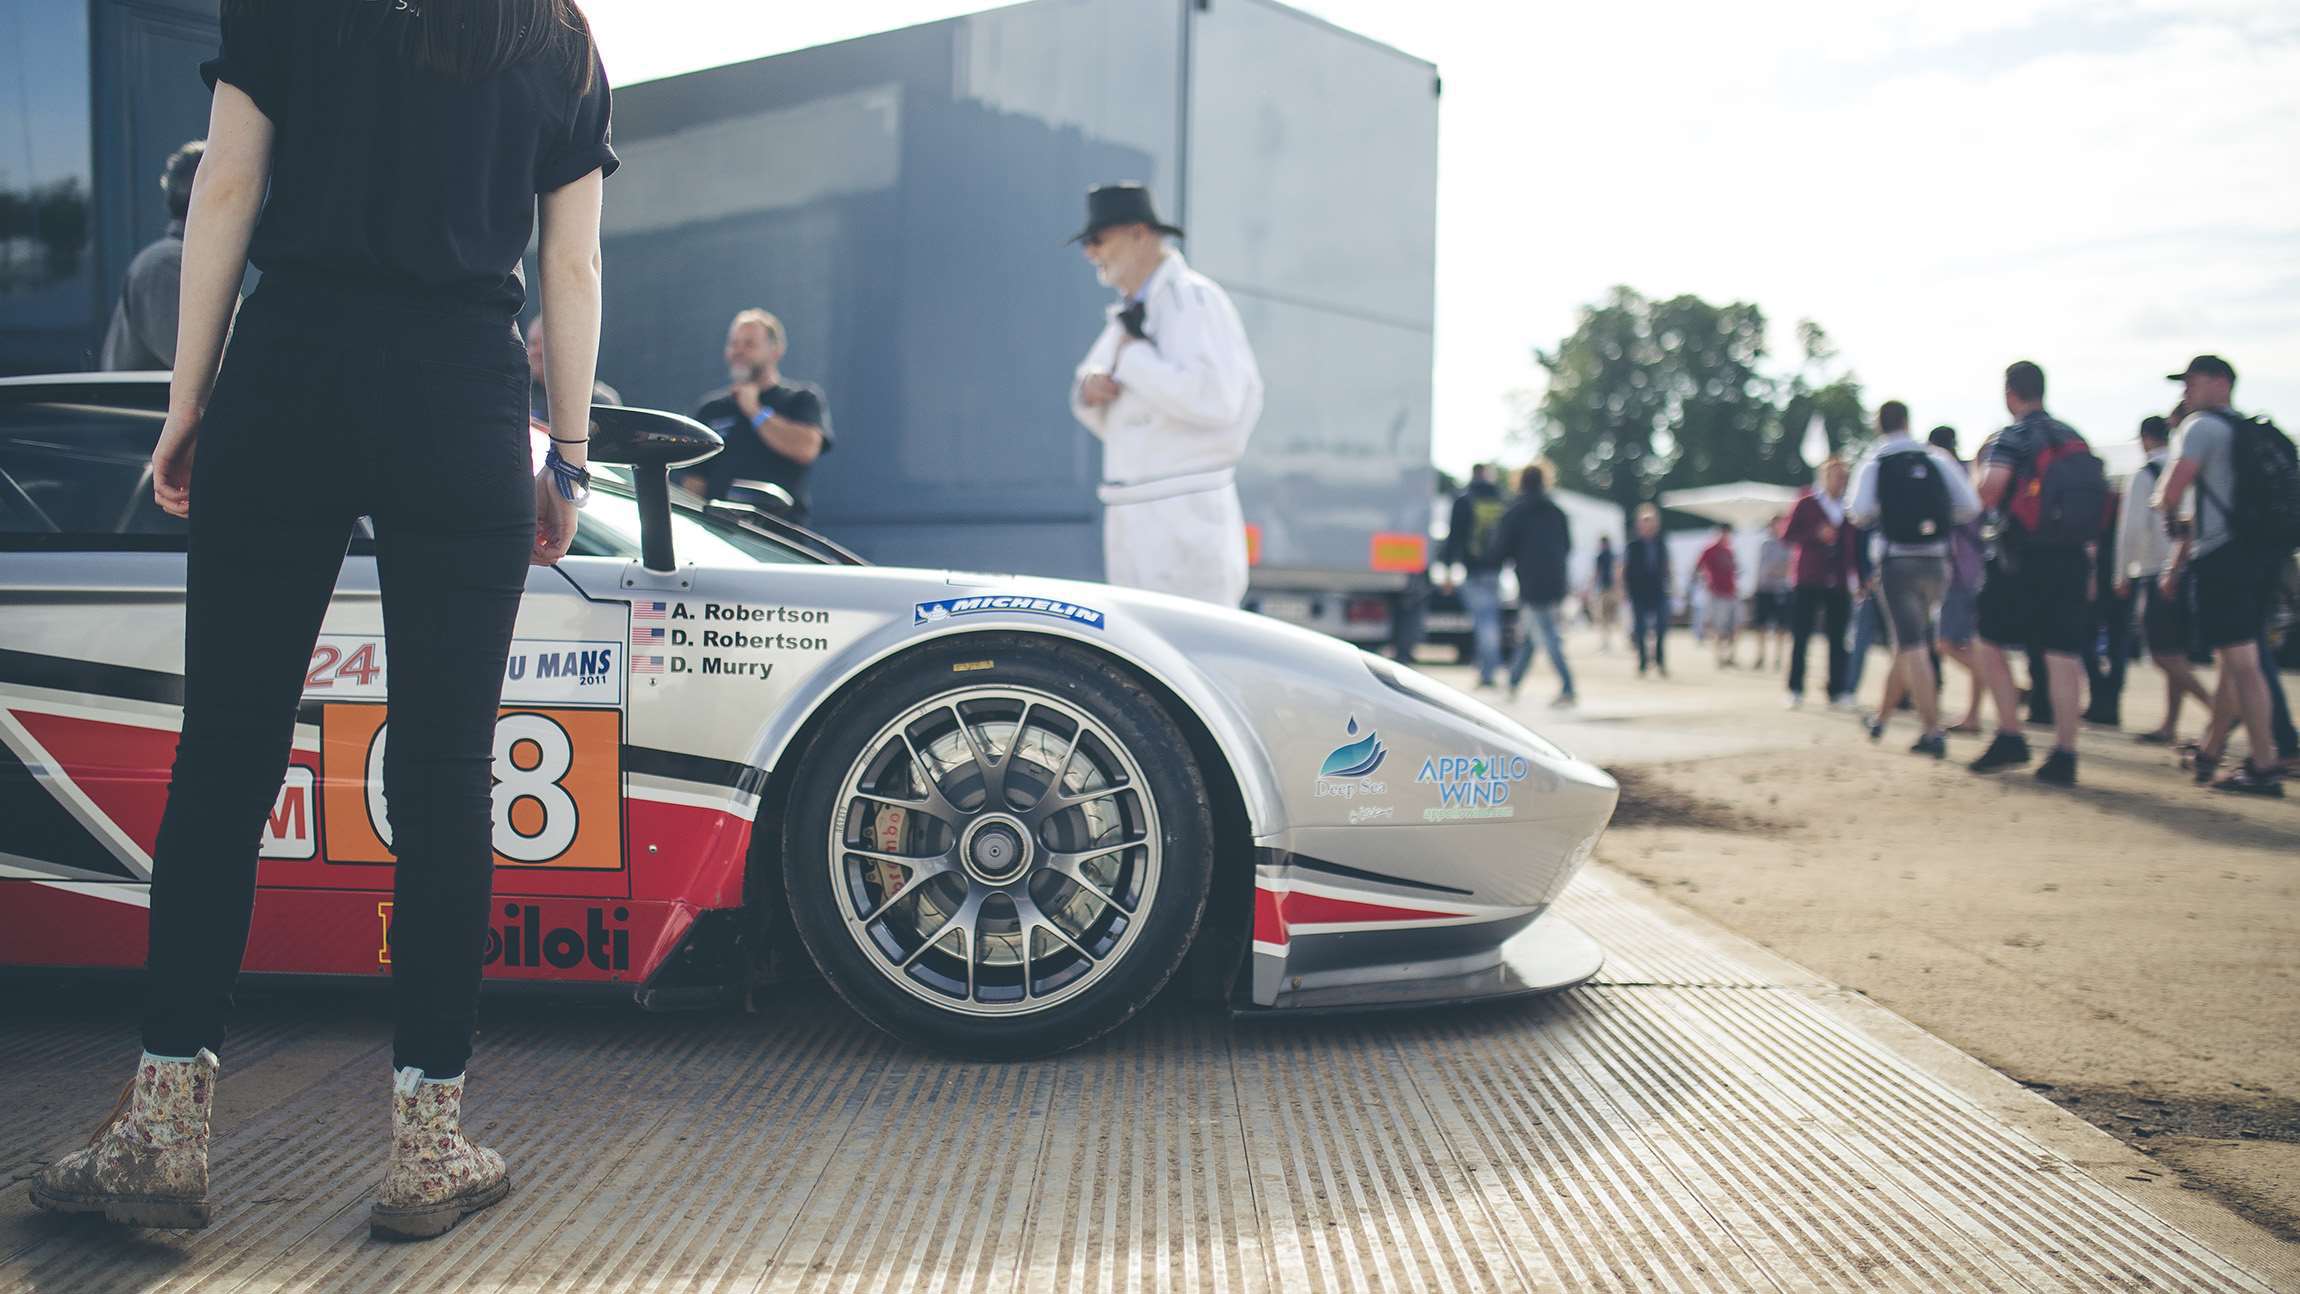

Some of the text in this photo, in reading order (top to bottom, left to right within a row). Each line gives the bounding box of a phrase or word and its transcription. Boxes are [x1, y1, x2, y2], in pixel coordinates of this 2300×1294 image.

[671, 603, 829, 624] A. Robertson
[951, 598, 1101, 622] MICHELIN
[671, 629, 828, 650] D. Robertson
[305, 643, 381, 688] 24
[508, 649, 611, 680] U MANS
[671, 656, 773, 679] D. Murry
[579, 675, 607, 686] 2011
[1415, 754, 1529, 783] APPOLLO
[1439, 779, 1509, 806] WIND
